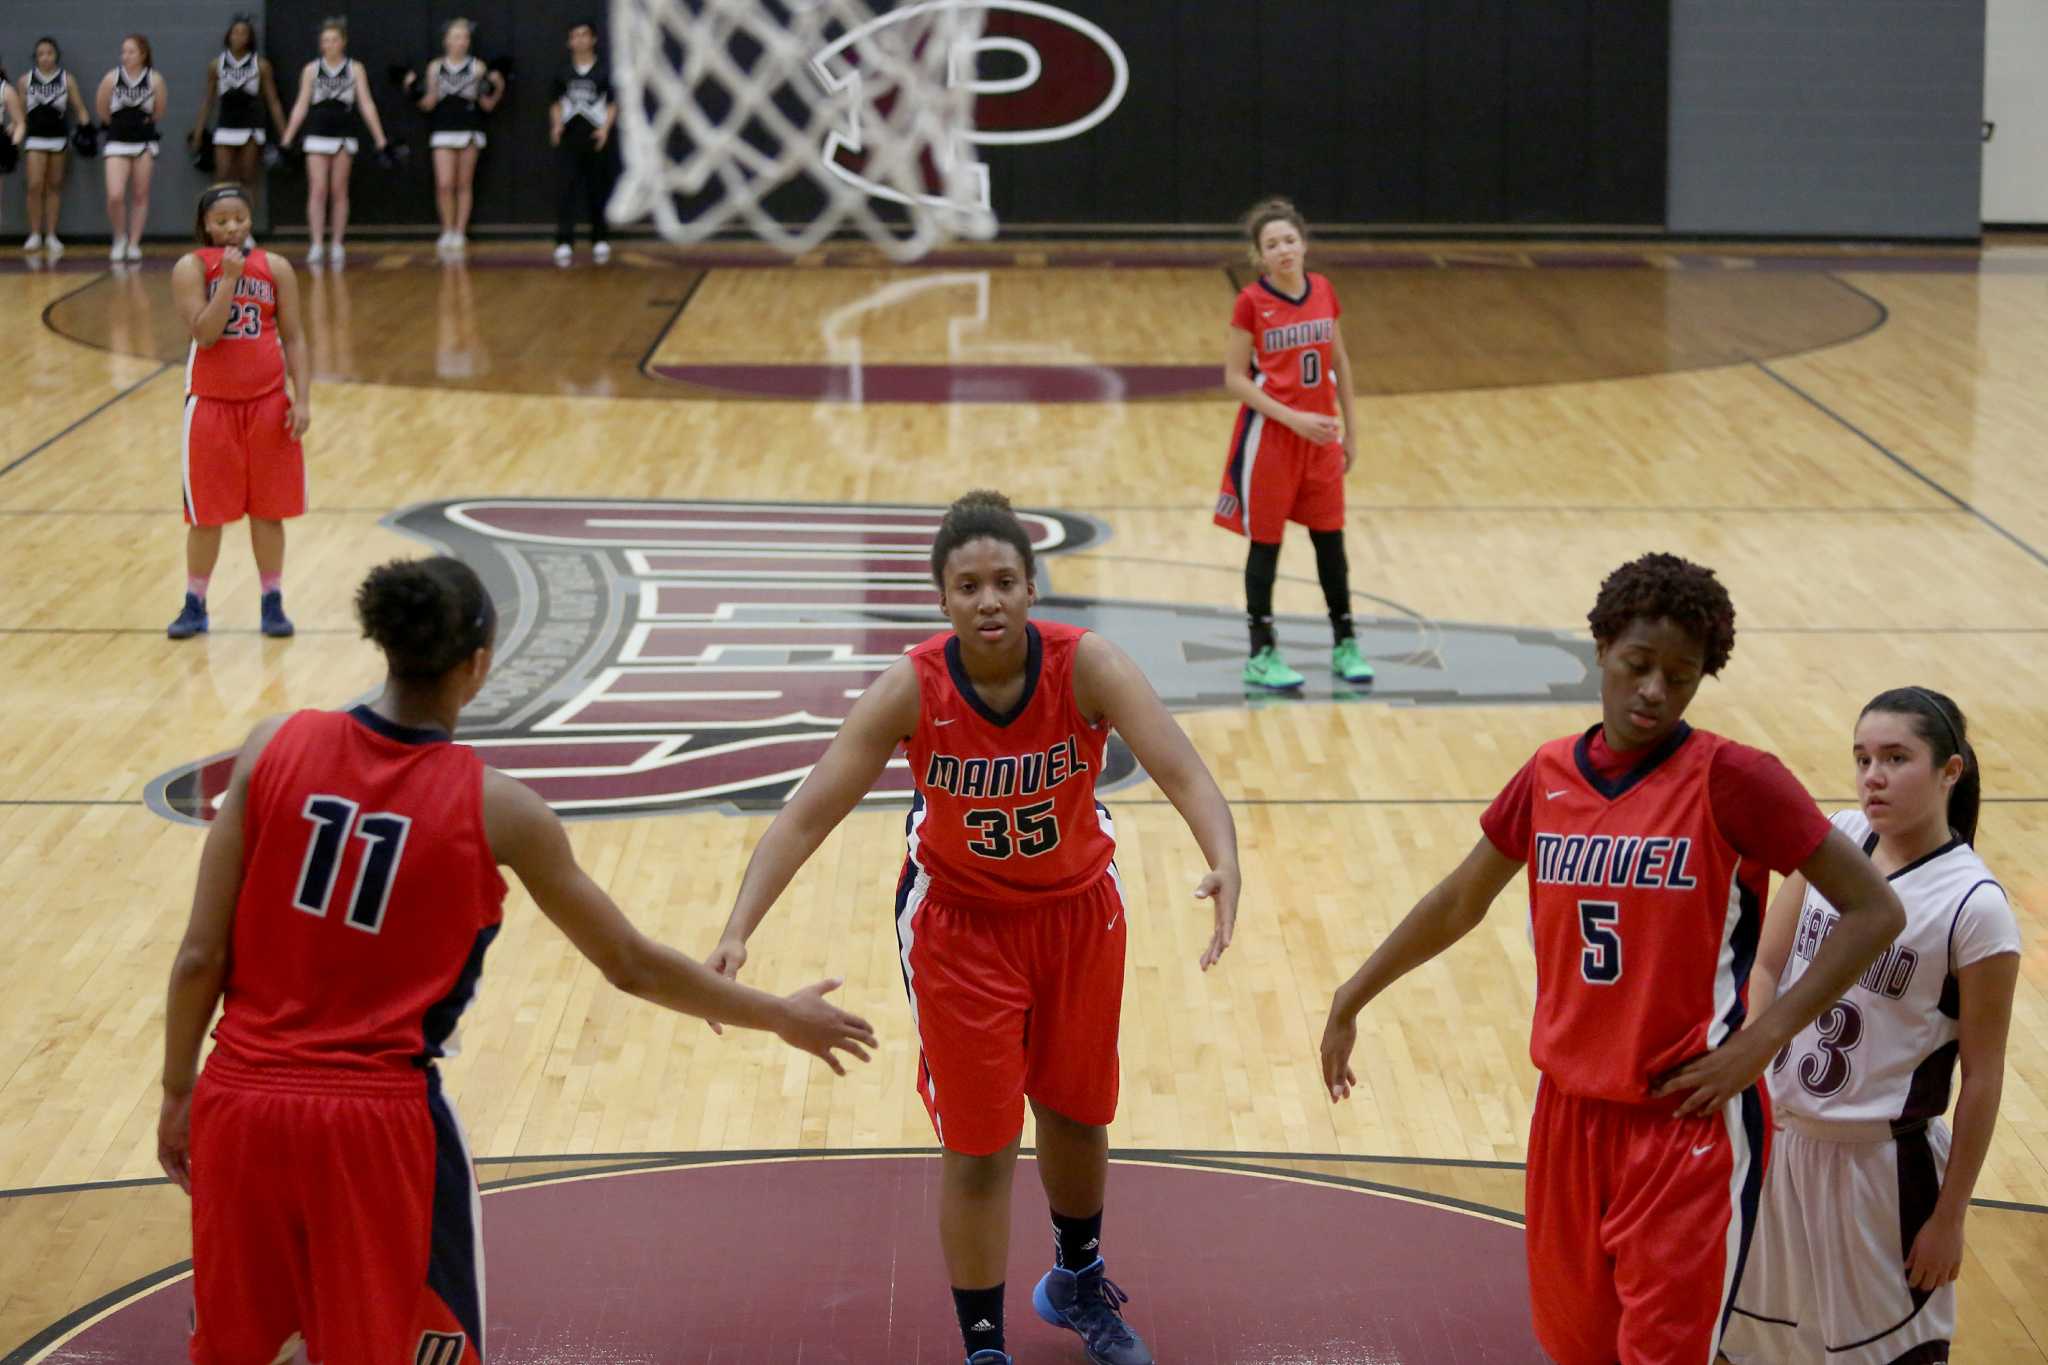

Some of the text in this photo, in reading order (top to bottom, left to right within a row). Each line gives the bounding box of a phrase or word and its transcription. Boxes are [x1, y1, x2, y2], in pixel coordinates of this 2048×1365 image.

[222, 303, 261, 339] 23
[1301, 349, 1322, 388] 0
[926, 734, 1089, 798] MANVEL
[963, 797, 1061, 860] 35
[292, 794, 413, 934] 11
[1535, 832, 1697, 889] MANVEL
[1577, 900, 1623, 984] 5
